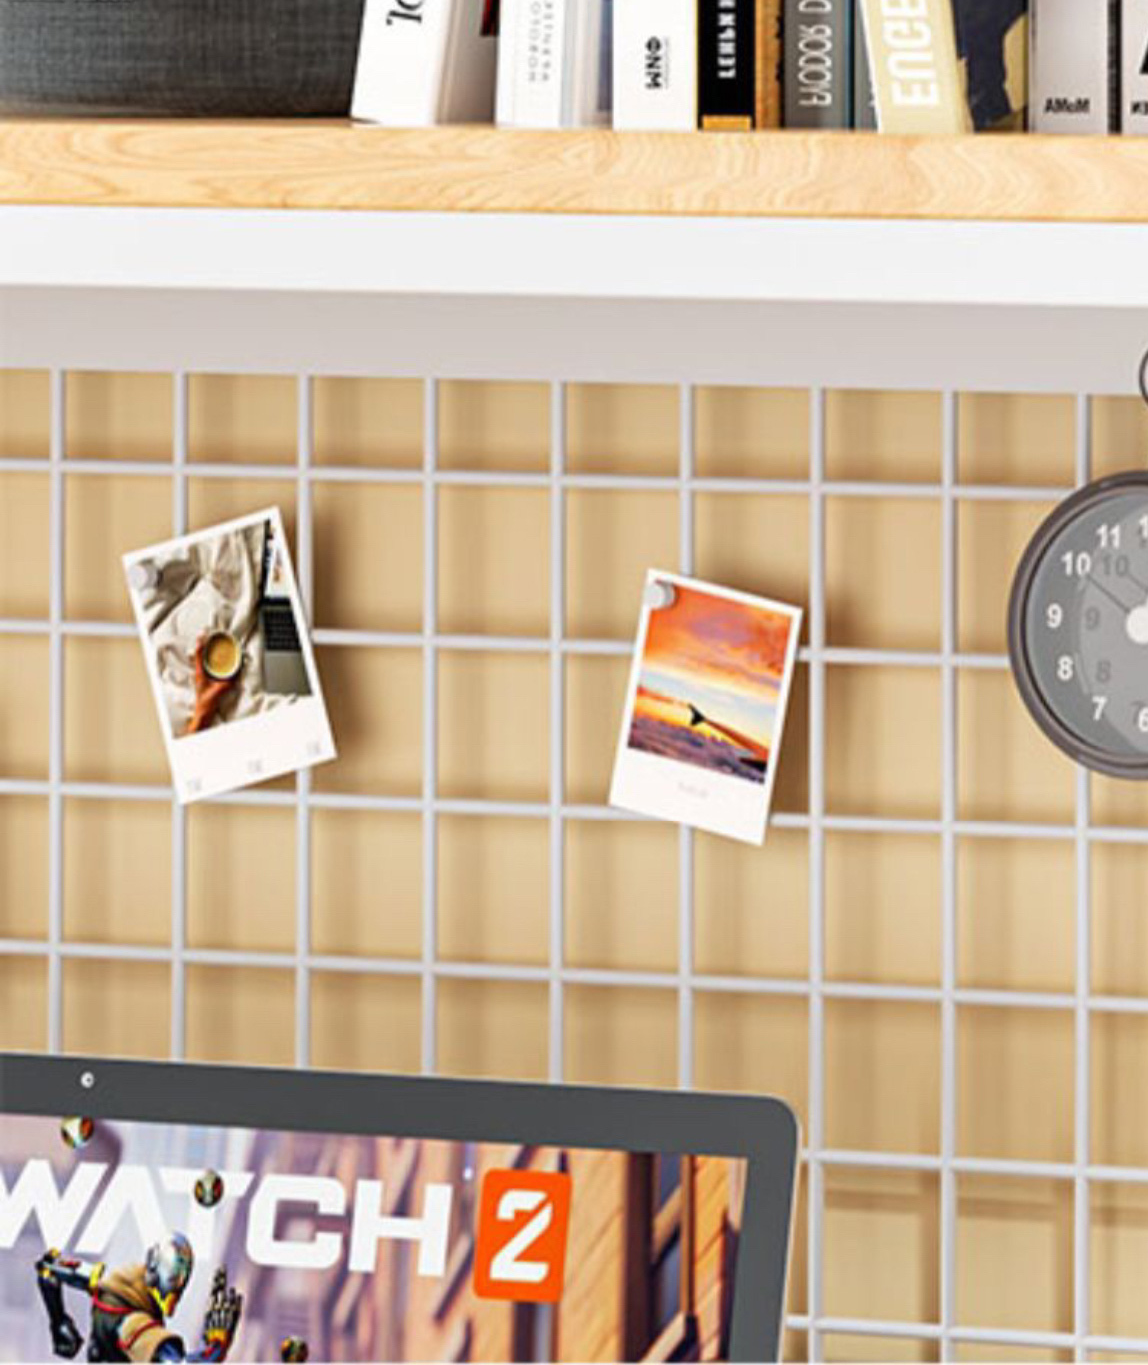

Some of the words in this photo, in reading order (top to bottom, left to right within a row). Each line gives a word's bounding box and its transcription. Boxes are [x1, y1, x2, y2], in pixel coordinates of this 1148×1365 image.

[1097, 525, 1121, 549] 11
[1061, 552, 1091, 576] 10
[1047, 604, 1061, 629] 9
[1058, 655, 1073, 681] 8
[1092, 697, 1107, 721] 7
[489, 1189, 554, 1284] 2
